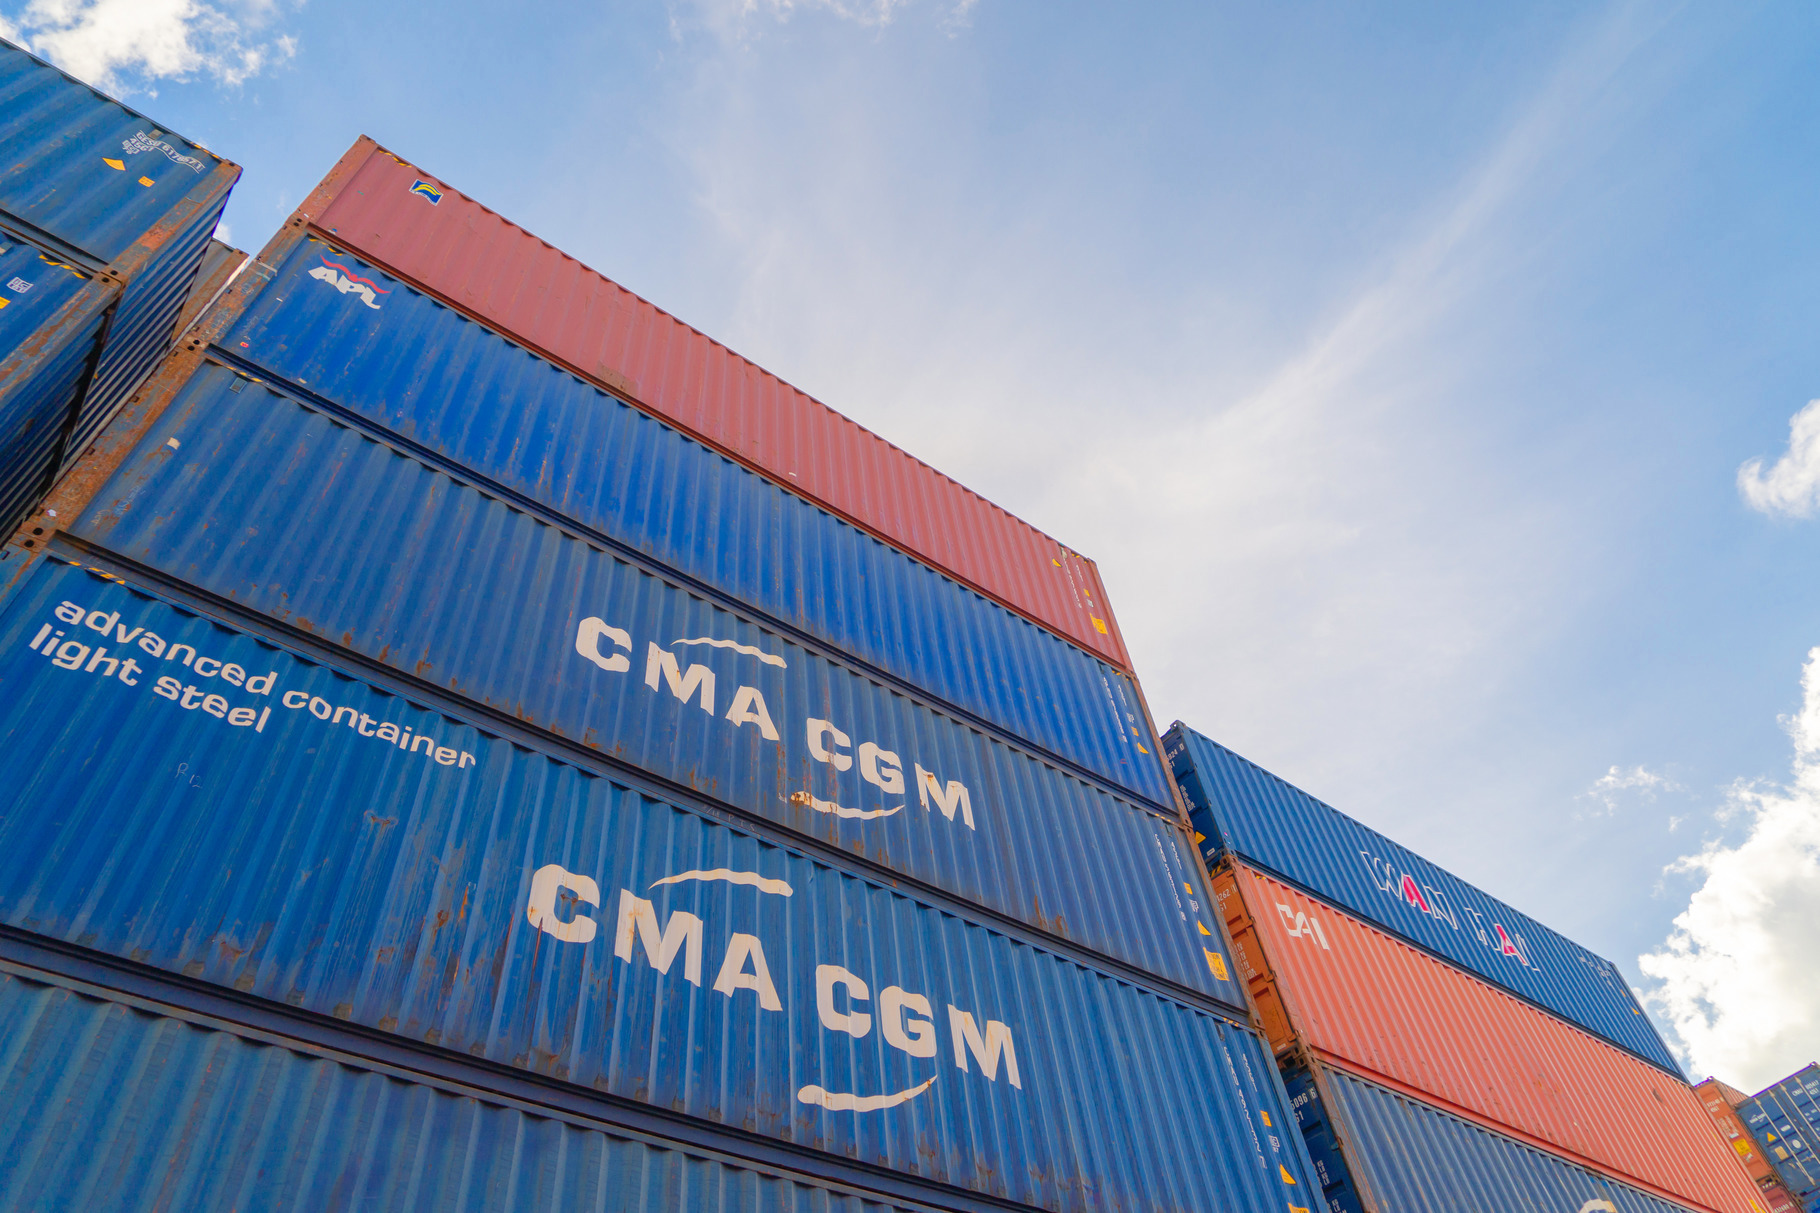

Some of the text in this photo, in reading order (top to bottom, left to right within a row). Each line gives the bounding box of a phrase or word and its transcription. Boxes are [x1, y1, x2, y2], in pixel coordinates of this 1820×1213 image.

[136, 131, 162, 147] GESU
[308, 267, 381, 310] APL
[29, 623, 271, 733] light steel
[54, 600, 476, 768] advanced container
[575, 616, 976, 832] CMA CGM
[1275, 901, 1330, 950] CAI
[1360, 851, 1458, 930] WAN
[527, 864, 1022, 1091] CMA CGM
[1223, 1046, 1240, 1086] CMAU
[1238, 1088, 1261, 1153] 492132
